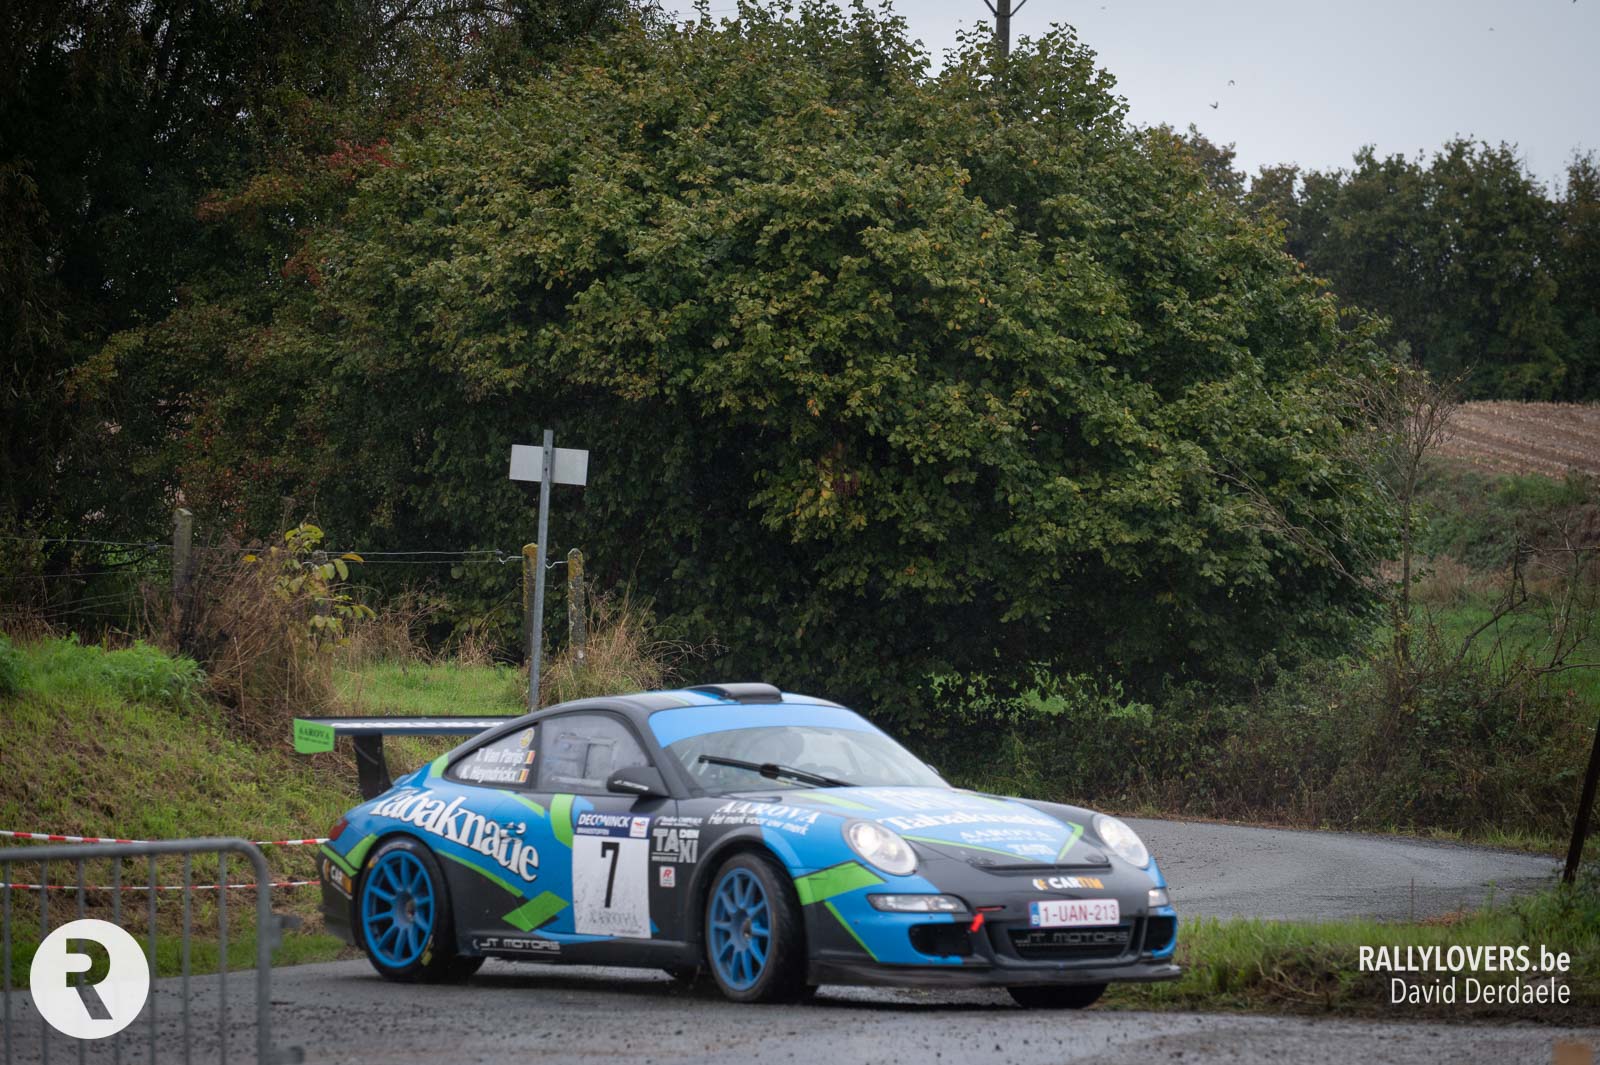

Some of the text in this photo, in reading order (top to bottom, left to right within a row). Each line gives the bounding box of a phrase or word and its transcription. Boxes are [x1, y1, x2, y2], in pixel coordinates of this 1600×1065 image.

[578, 814, 631, 828] DECONINCK
[601, 841, 620, 908] 7
[1042, 904, 1118, 923] 1-UAN-213
[503, 938, 561, 951] MOTORS
